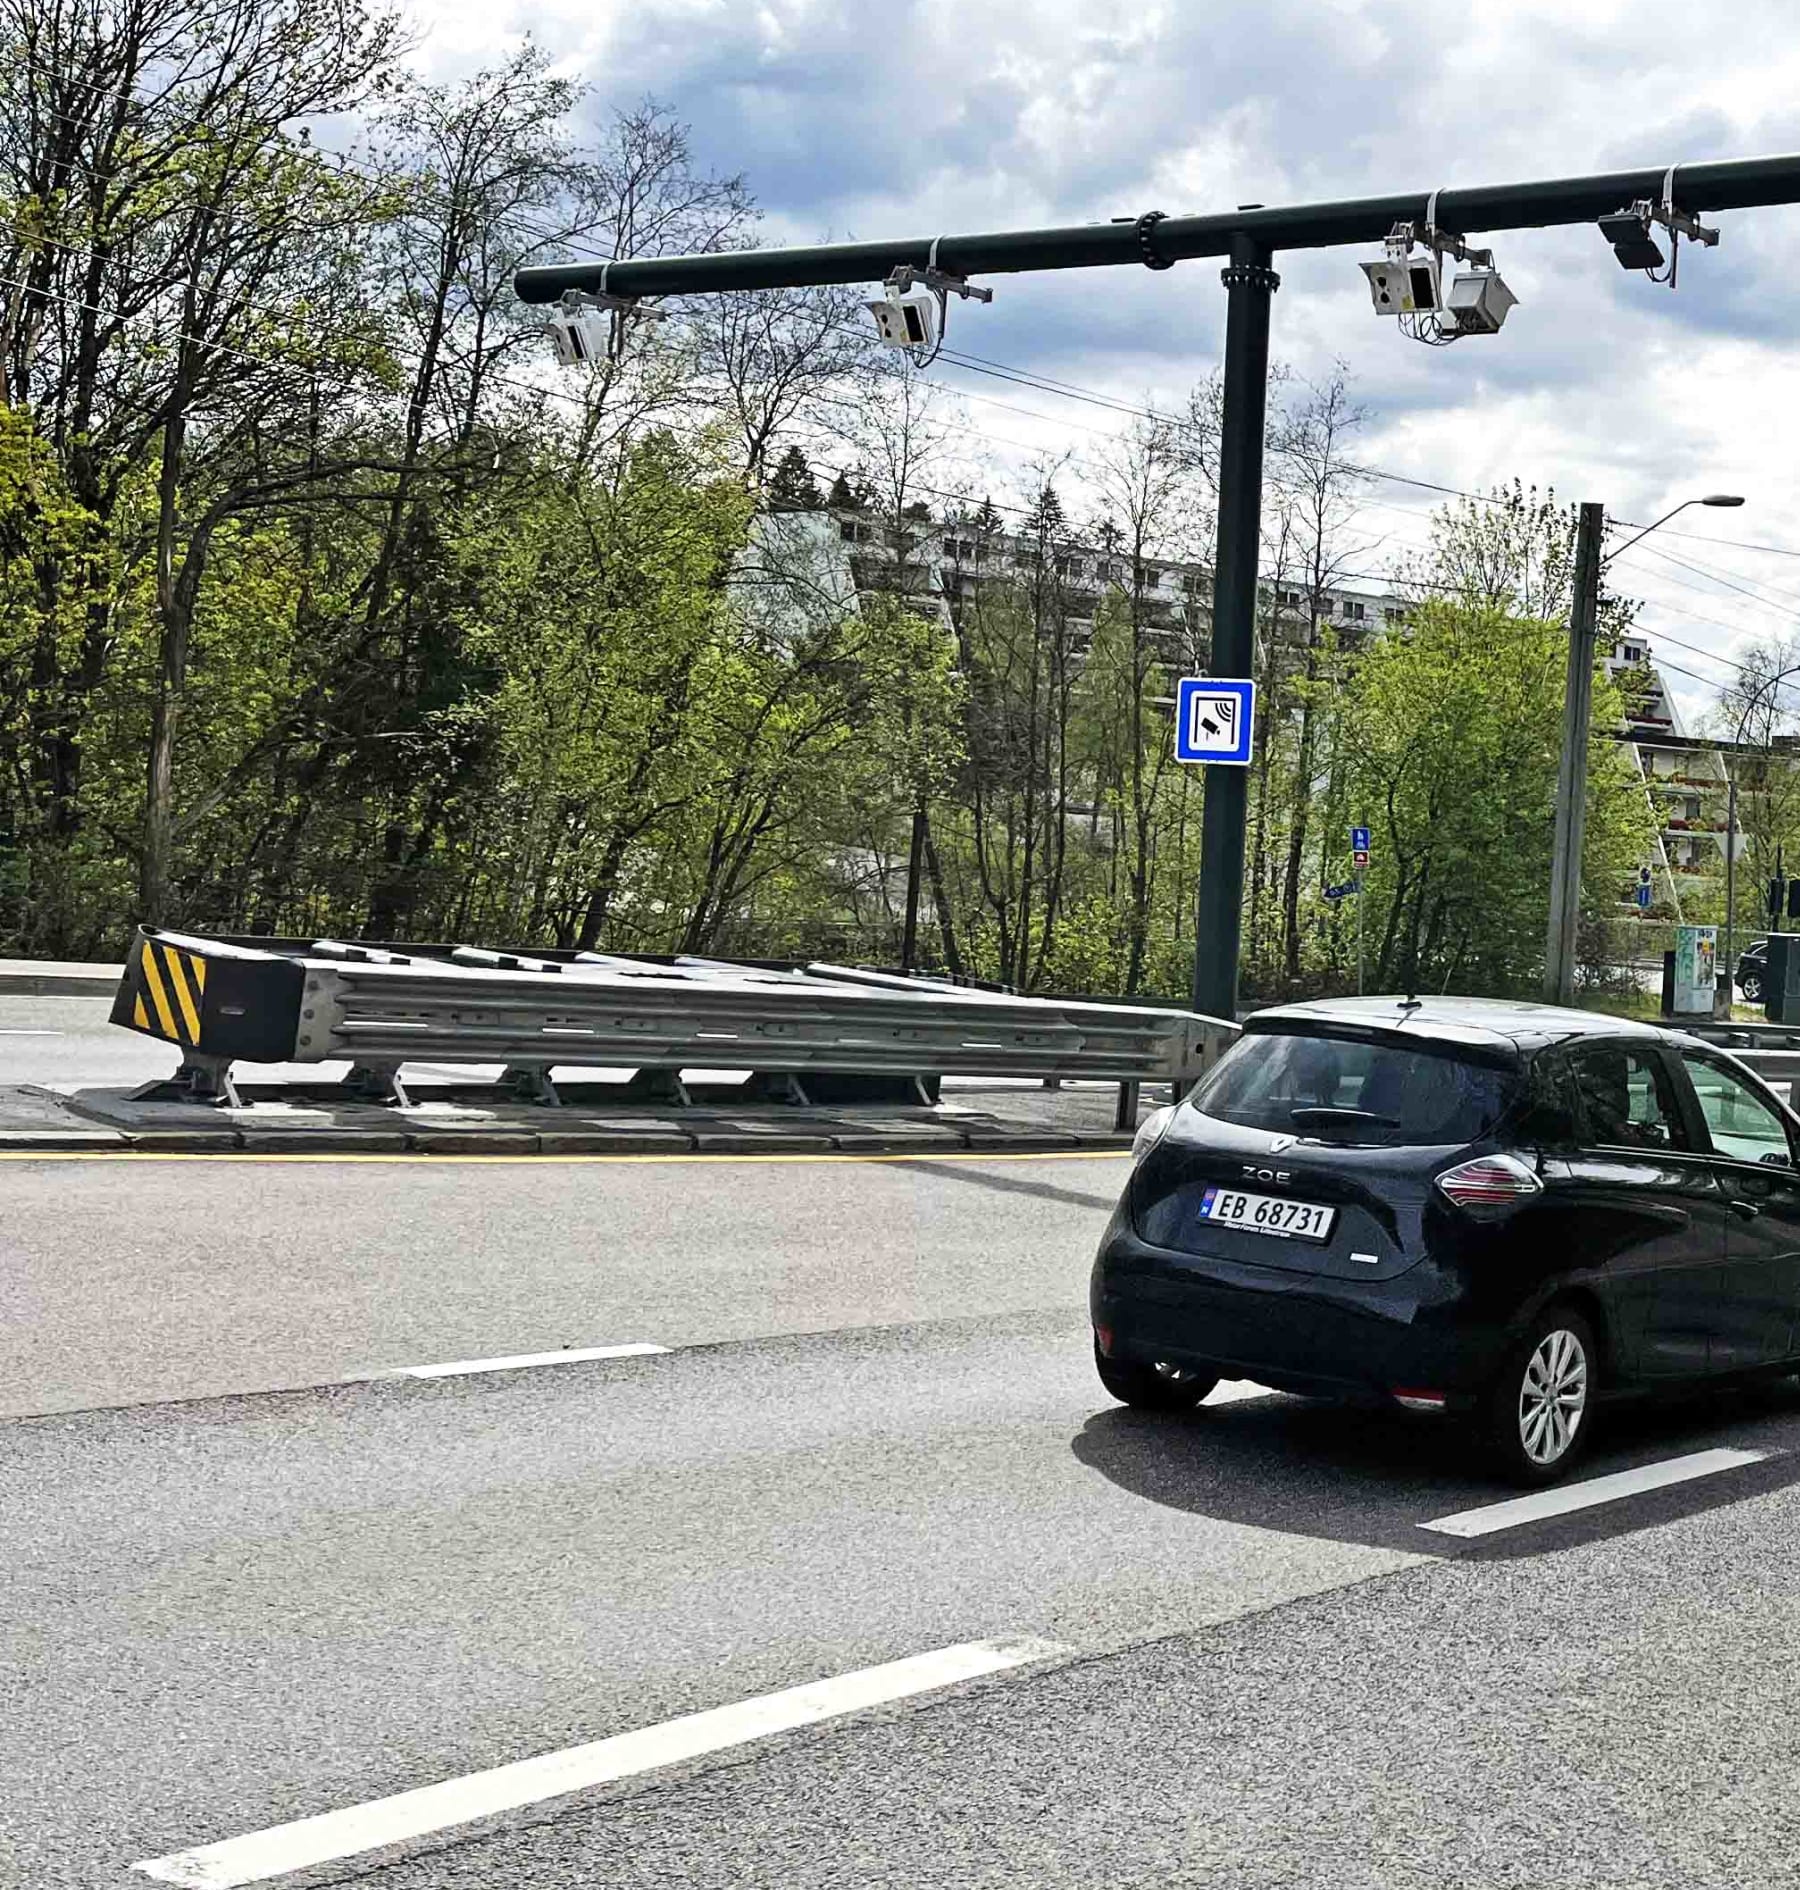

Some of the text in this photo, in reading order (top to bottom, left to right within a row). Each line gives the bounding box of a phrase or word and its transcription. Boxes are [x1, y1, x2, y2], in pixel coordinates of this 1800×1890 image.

[1242, 1165, 1291, 1185] ZOE
[1218, 1194, 1247, 1219] EB
[1254, 1200, 1325, 1234] 68731
